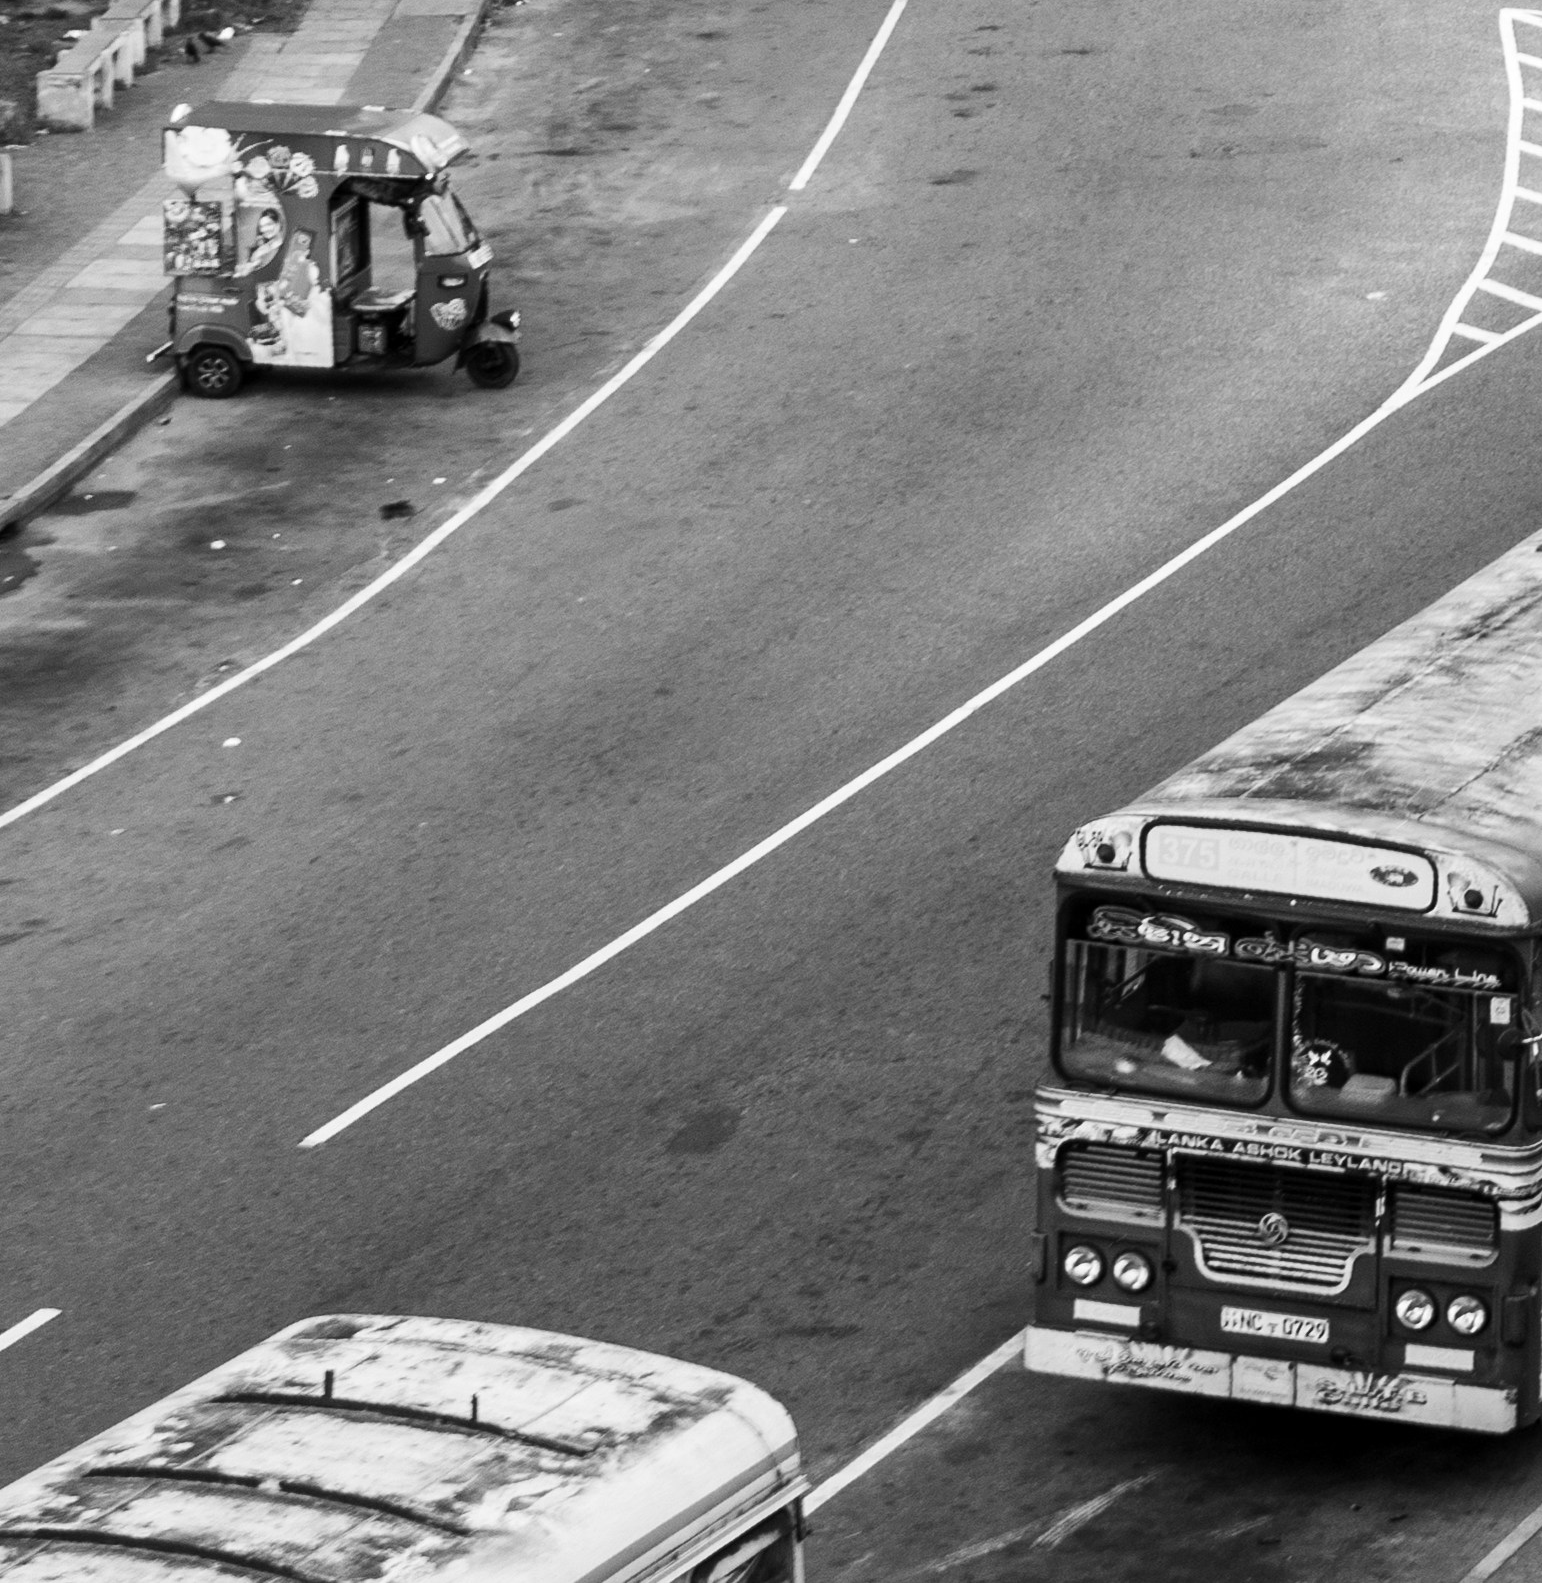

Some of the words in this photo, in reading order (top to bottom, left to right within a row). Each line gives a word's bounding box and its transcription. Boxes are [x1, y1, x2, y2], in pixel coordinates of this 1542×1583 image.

[1162, 837, 1215, 868] 375
[1155, 1131, 1224, 1152] LANKA
[1231, 1141, 1301, 1162] ASHOK
[1310, 1149, 1403, 1175] LEYLAND
[1283, 1317, 1327, 1340] 0729
